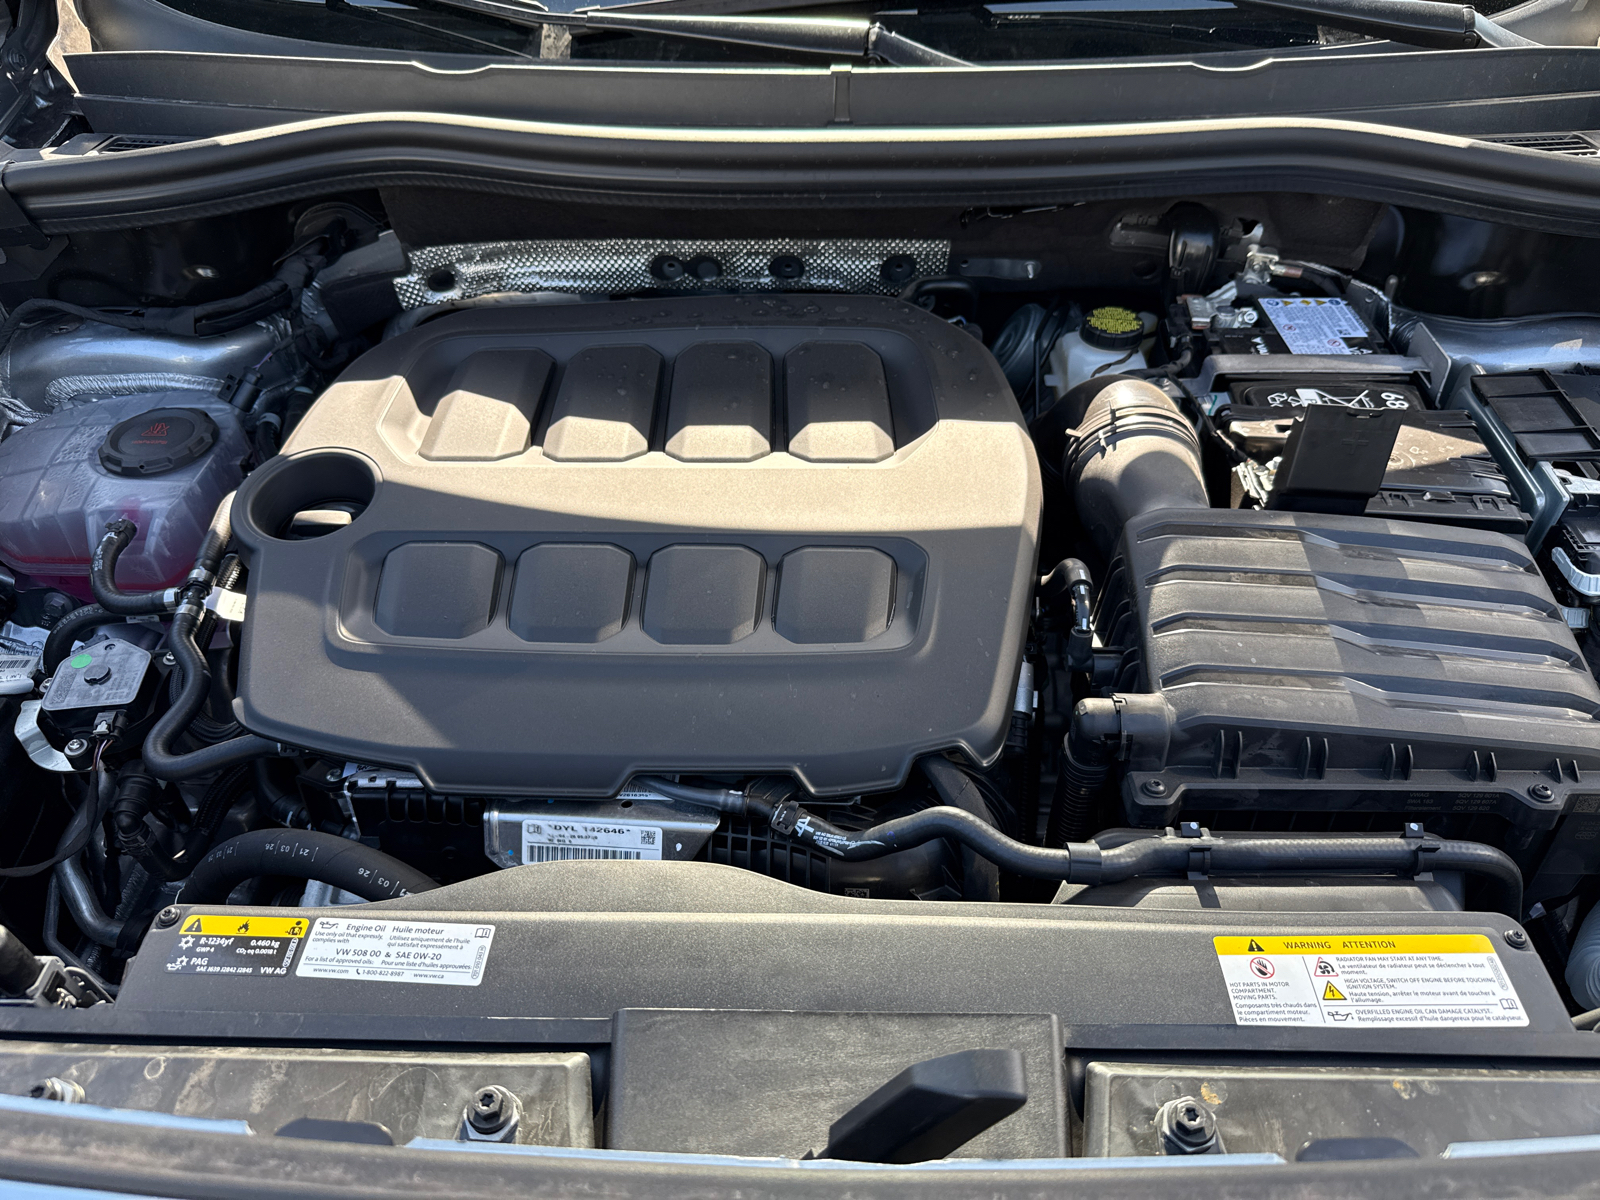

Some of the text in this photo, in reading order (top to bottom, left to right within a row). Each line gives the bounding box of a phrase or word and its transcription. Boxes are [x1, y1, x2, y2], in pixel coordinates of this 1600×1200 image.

[358, 867, 390, 888] 03 26
[346, 924, 373, 932] Engine
[200, 937, 235, 946] R-1234yf
[413, 952, 442, 960] 0W-20
